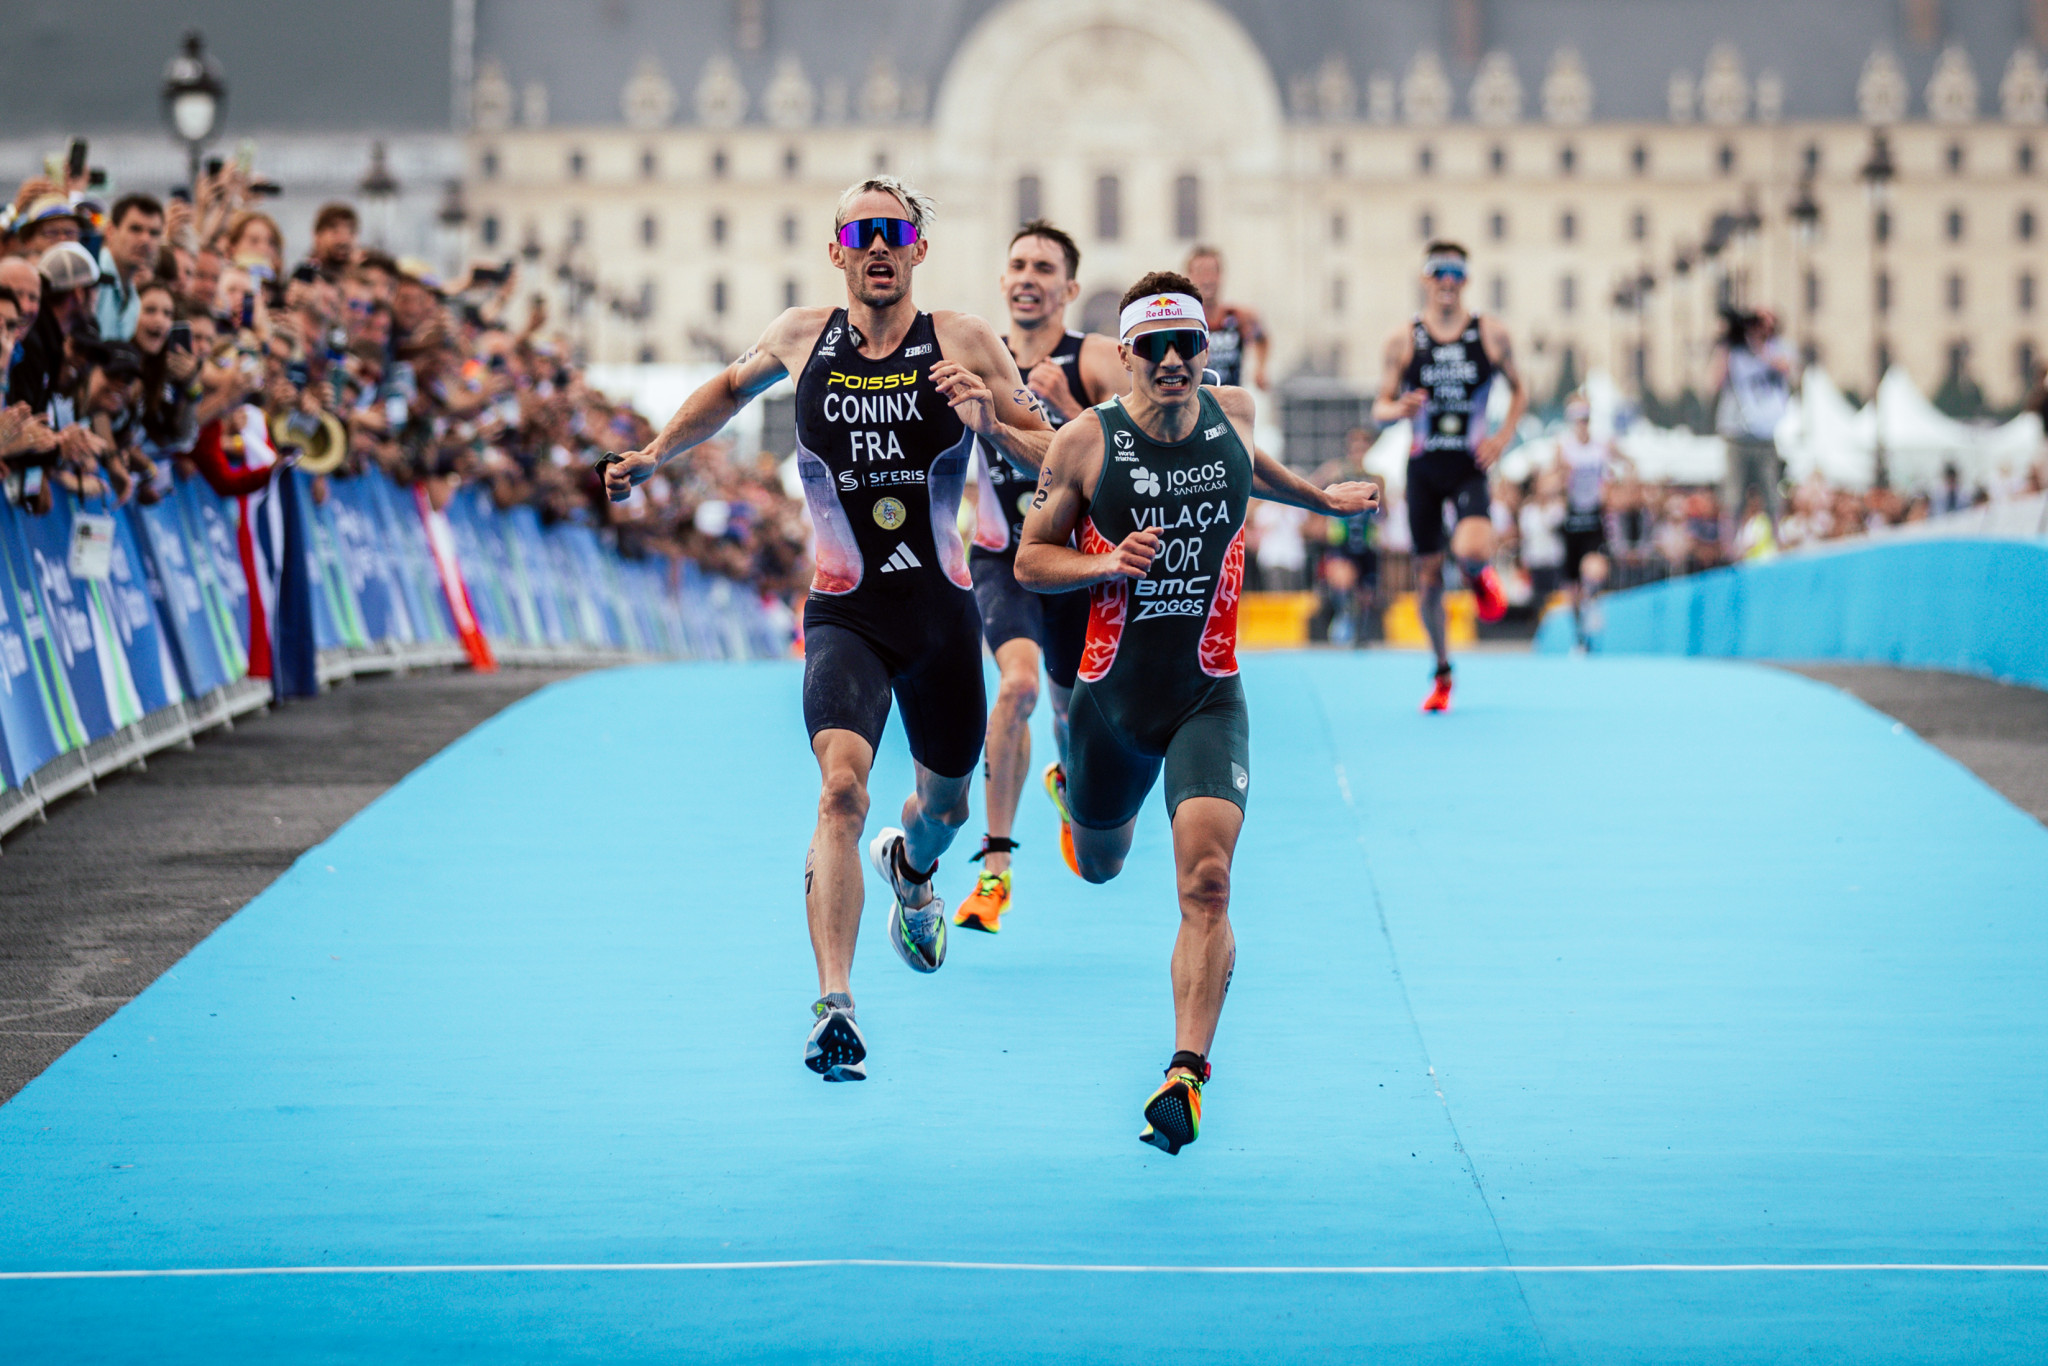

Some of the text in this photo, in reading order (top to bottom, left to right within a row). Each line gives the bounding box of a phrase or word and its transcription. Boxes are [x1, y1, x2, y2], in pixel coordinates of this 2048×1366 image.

[1145, 308, 1183, 318] Red Bull
[827, 369, 918, 390] POISSY
[823, 390, 923, 424] CONINX
[850, 430, 905, 462] FRA
[869, 470, 925, 483] SFERIS
[1166, 460, 1226, 493] JOGOS
[1032, 488, 1048, 510] 2
[1130, 500, 1231, 533] VILAÇA
[1131, 598, 1205, 623] ZOGGS
